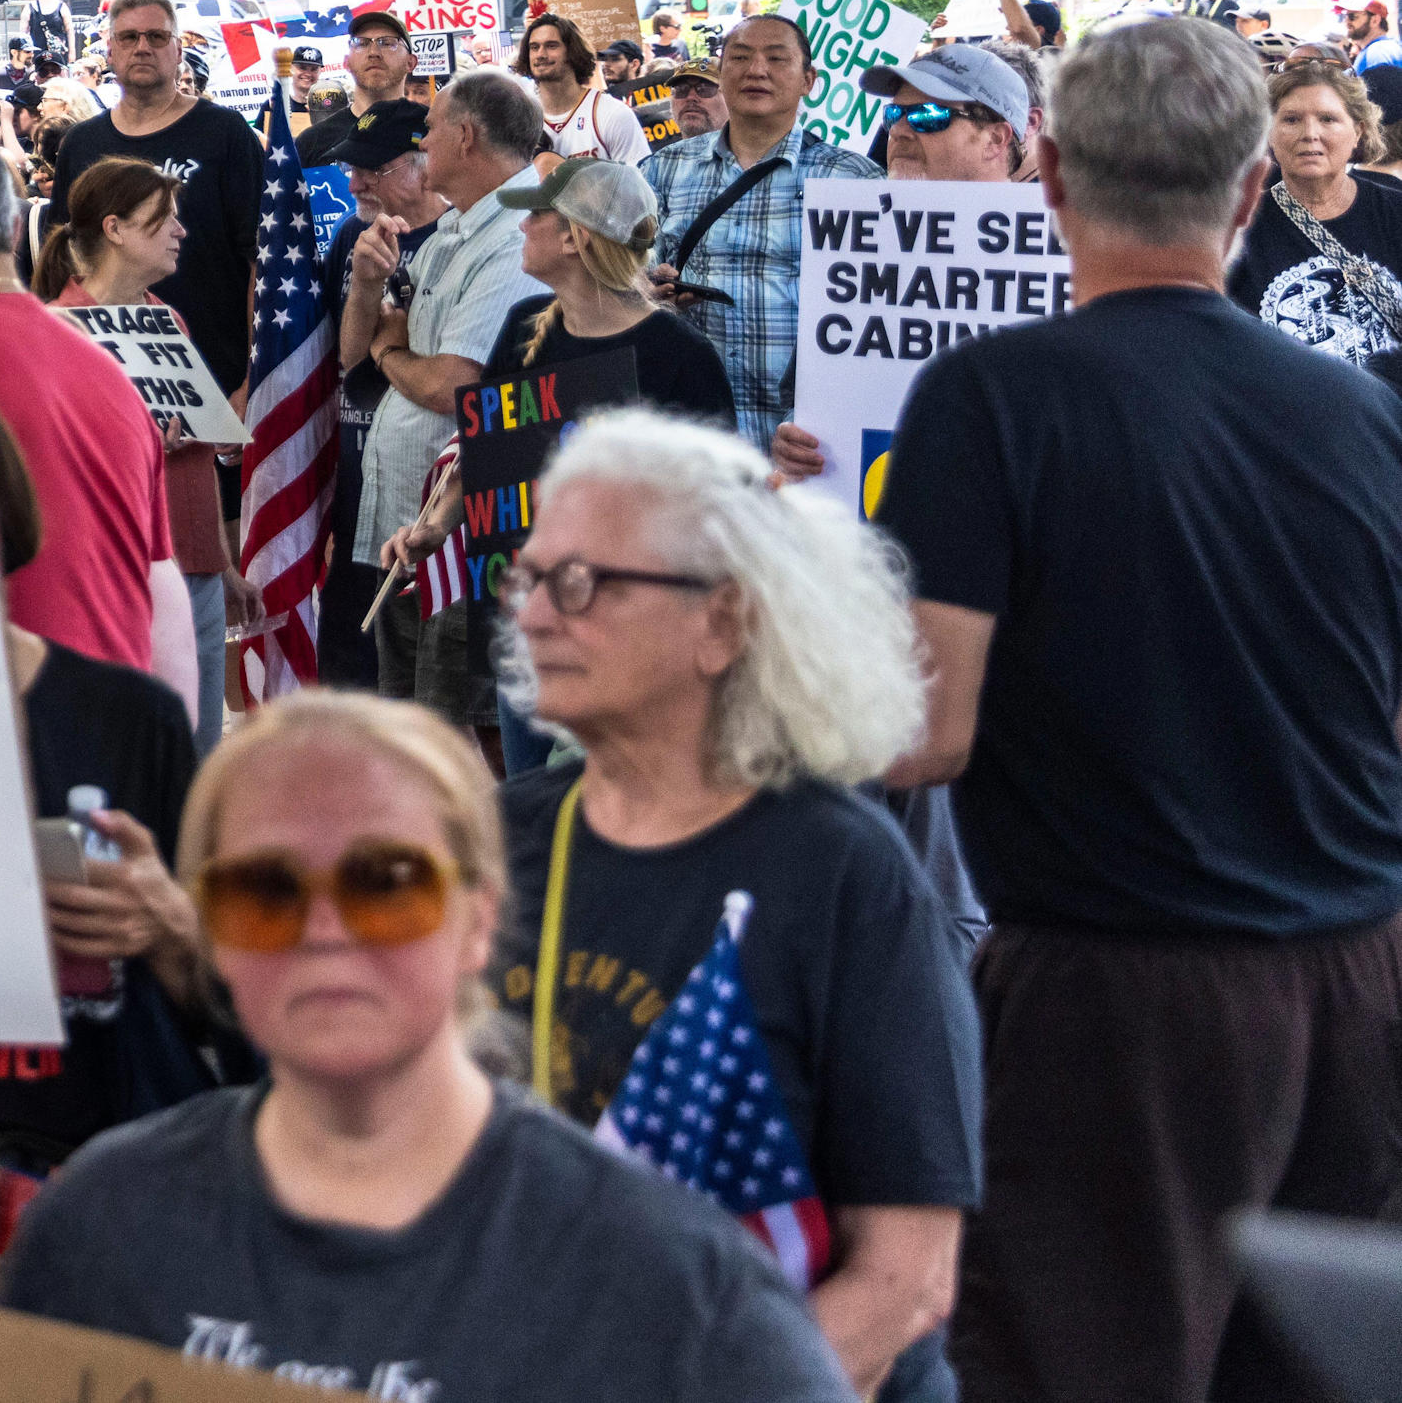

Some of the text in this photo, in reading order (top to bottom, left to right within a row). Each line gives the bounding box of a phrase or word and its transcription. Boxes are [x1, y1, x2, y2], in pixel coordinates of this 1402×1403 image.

[405, 2, 496, 32] KINGS
[412, 38, 445, 53] STOP
[220, 88, 251, 98] NATION
[807, 192, 956, 255] WE'VE
[136, 342, 195, 370] FIT
[134, 377, 203, 407] THIS
[461, 372, 562, 439] SPEAK
[464, 480, 540, 539] WHI
[466, 548, 520, 602] YO
